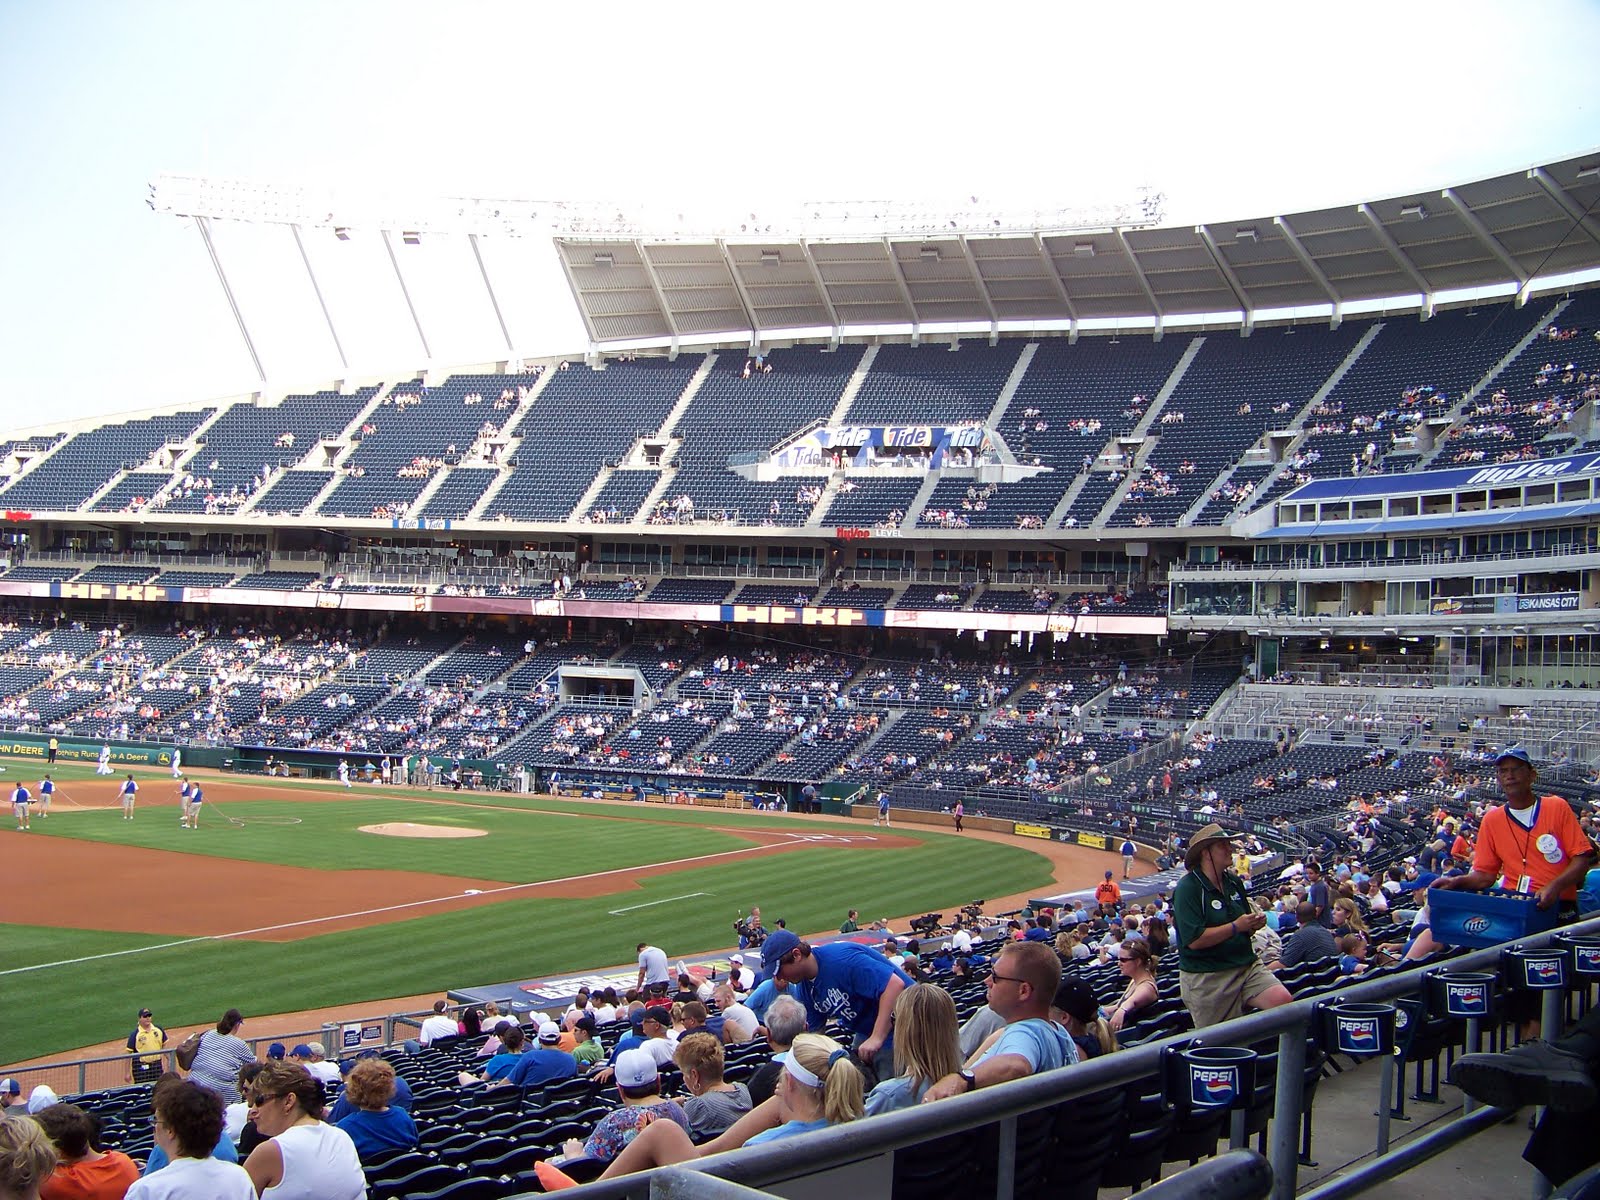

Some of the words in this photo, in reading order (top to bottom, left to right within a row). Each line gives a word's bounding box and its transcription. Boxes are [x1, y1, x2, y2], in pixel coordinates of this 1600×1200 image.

[887, 427, 927, 446] Tide
[793, 446, 822, 466] Tide
[876, 529, 904, 538] LEVEL
[1529, 597, 1561, 610] KANSAS
[1561, 596, 1579, 608] CITY
[13, 743, 44, 756] DEERE
[56, 746, 80, 758] othing
[81, 749, 99, 759] Runs
[126, 753, 149, 761] Deere
[1070, 798, 1093, 807] CROWN
[1100, 884, 1113, 893] 360
[1578, 949, 1600, 958] PEP
[1528, 961, 1558, 971] PEPSI
[1449, 987, 1483, 997] PEPSI
[840, 1007, 858, 1021] 16
[1340, 1021, 1374, 1032] PEPSI
[1193, 1070, 1233, 1082] PEPSI
